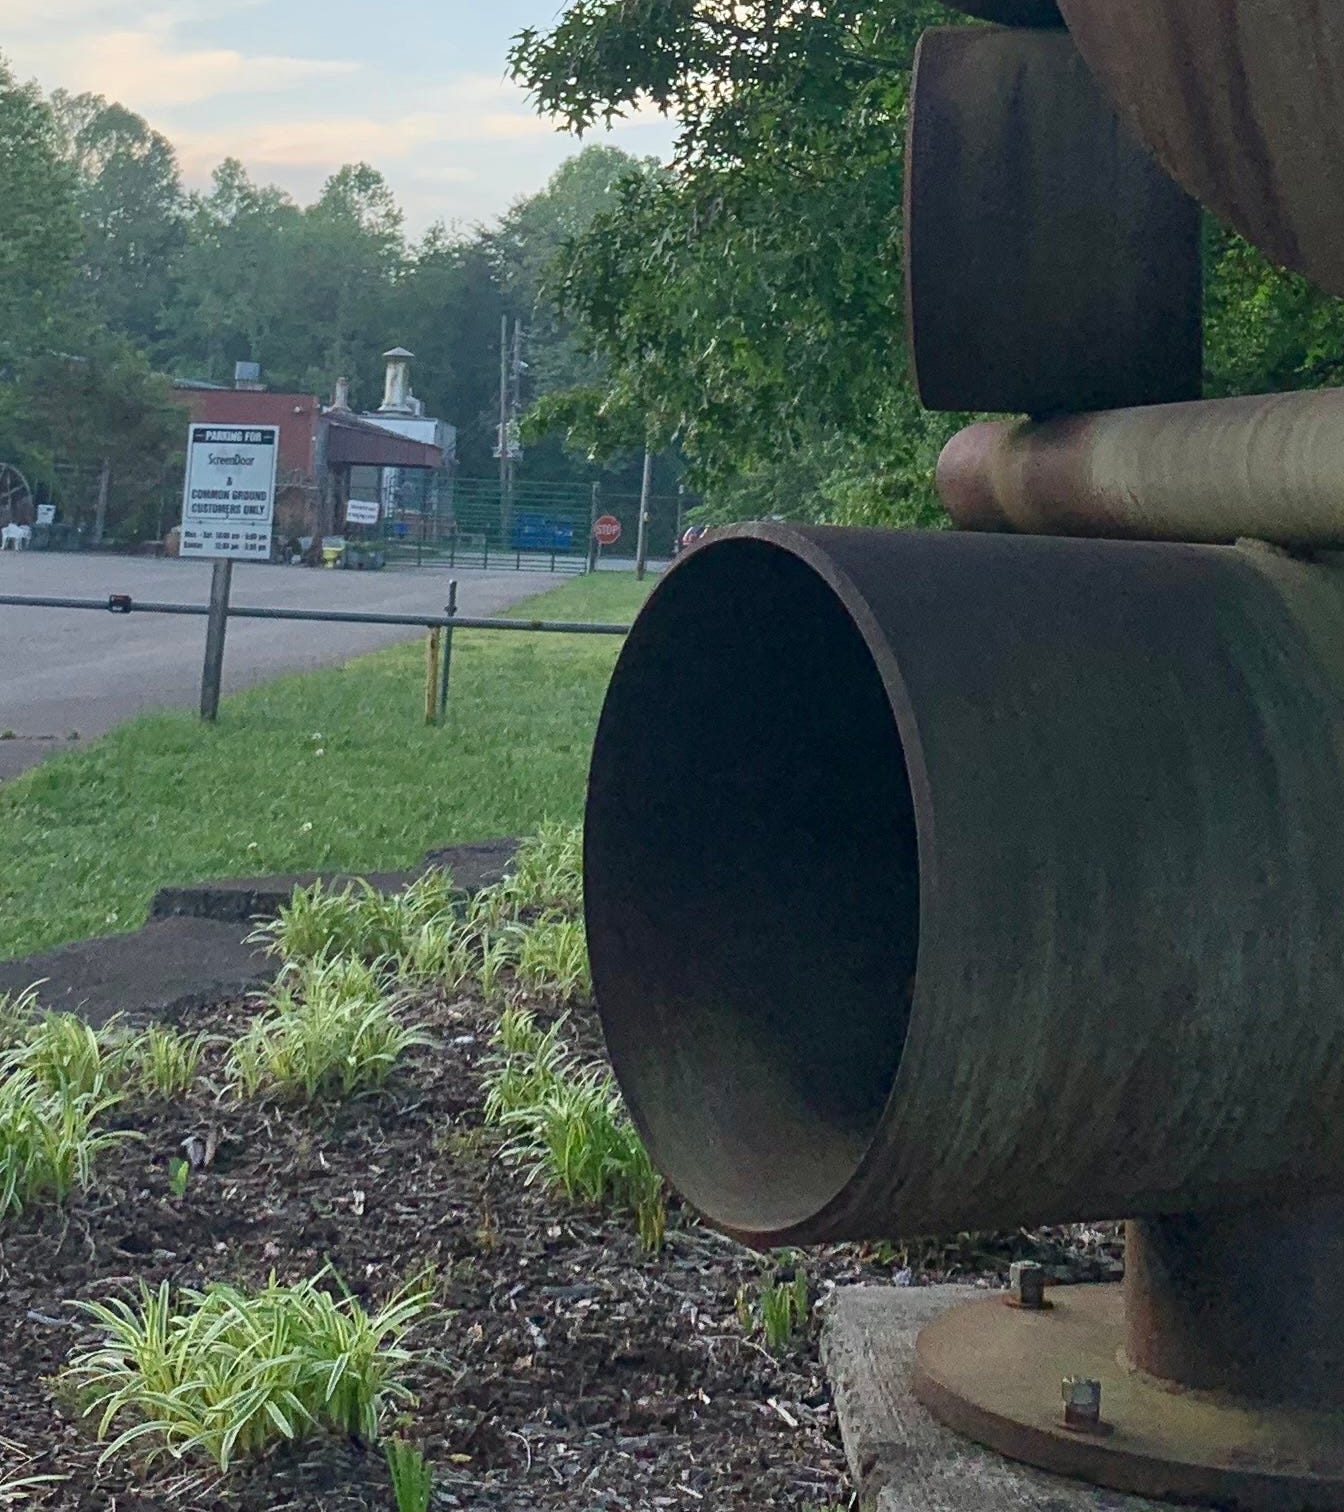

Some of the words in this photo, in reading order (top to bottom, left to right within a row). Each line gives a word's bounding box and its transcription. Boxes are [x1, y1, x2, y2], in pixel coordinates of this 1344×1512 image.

[205, 430, 243, 442] PARKING
[244, 432, 262, 442] FOR
[208, 452, 255, 466] ScreenDoor
[191, 489, 230, 500] COMMON
[231, 490, 267, 501] GROUND
[191, 503, 241, 515] CUSTOMERS
[243, 505, 265, 515] ONLY
